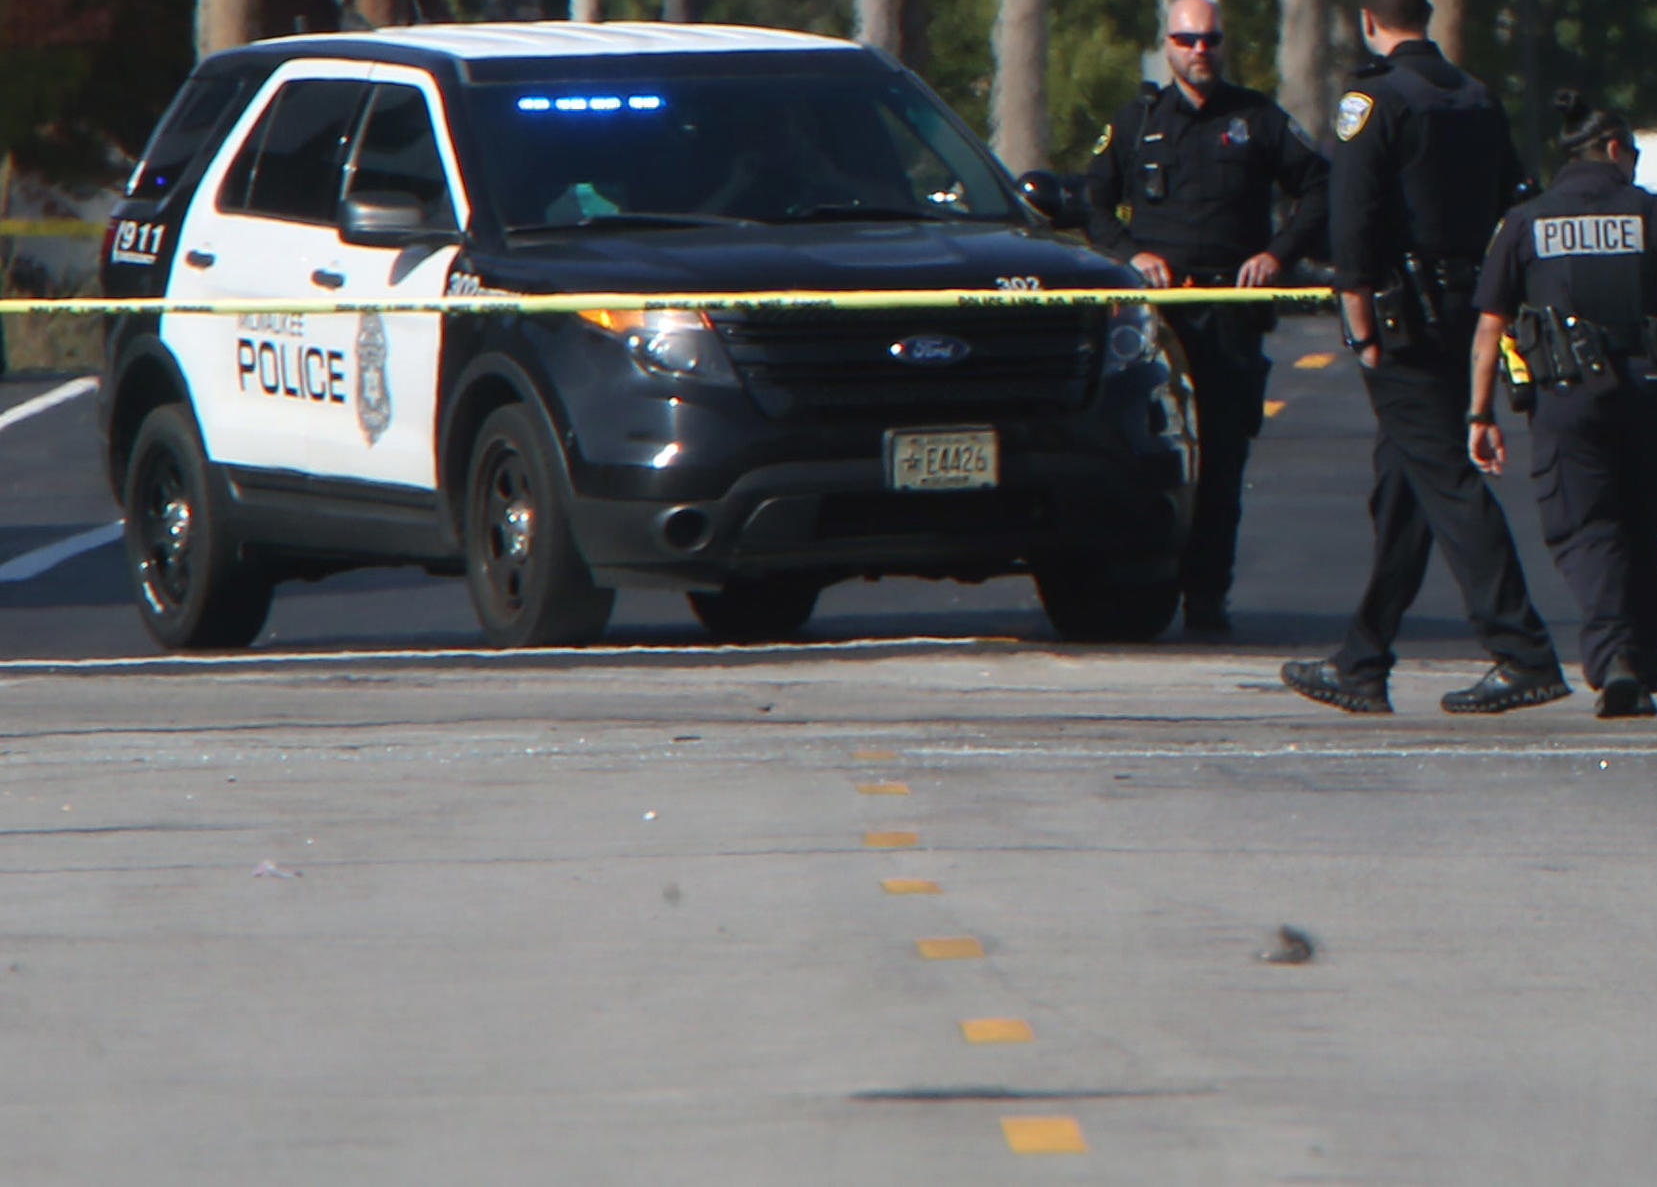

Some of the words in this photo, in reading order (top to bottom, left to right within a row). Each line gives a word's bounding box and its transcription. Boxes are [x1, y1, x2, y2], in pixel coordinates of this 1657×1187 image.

[117, 219, 167, 254] 911
[1544, 219, 1634, 252] POLICE
[236, 336, 346, 404] POLICE
[926, 446, 988, 475] E4426
